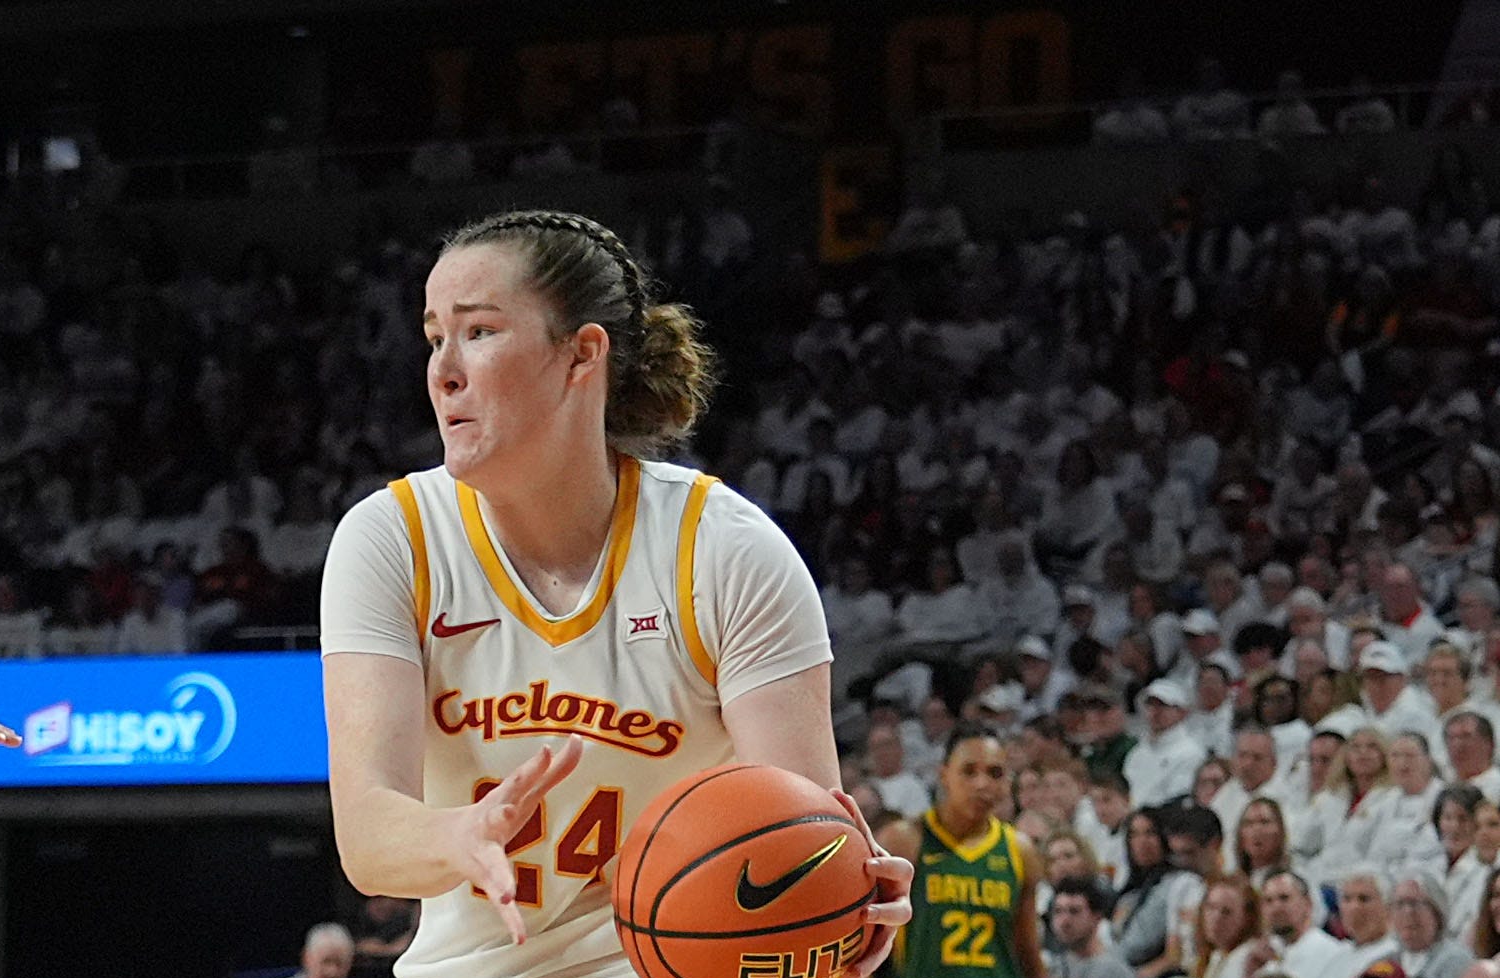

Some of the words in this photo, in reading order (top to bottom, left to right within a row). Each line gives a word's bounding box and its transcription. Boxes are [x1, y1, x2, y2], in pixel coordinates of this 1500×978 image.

[432, 679, 685, 760] Cyclones
[925, 873, 1011, 909] BAYLOR
[940, 909, 997, 968] 22
